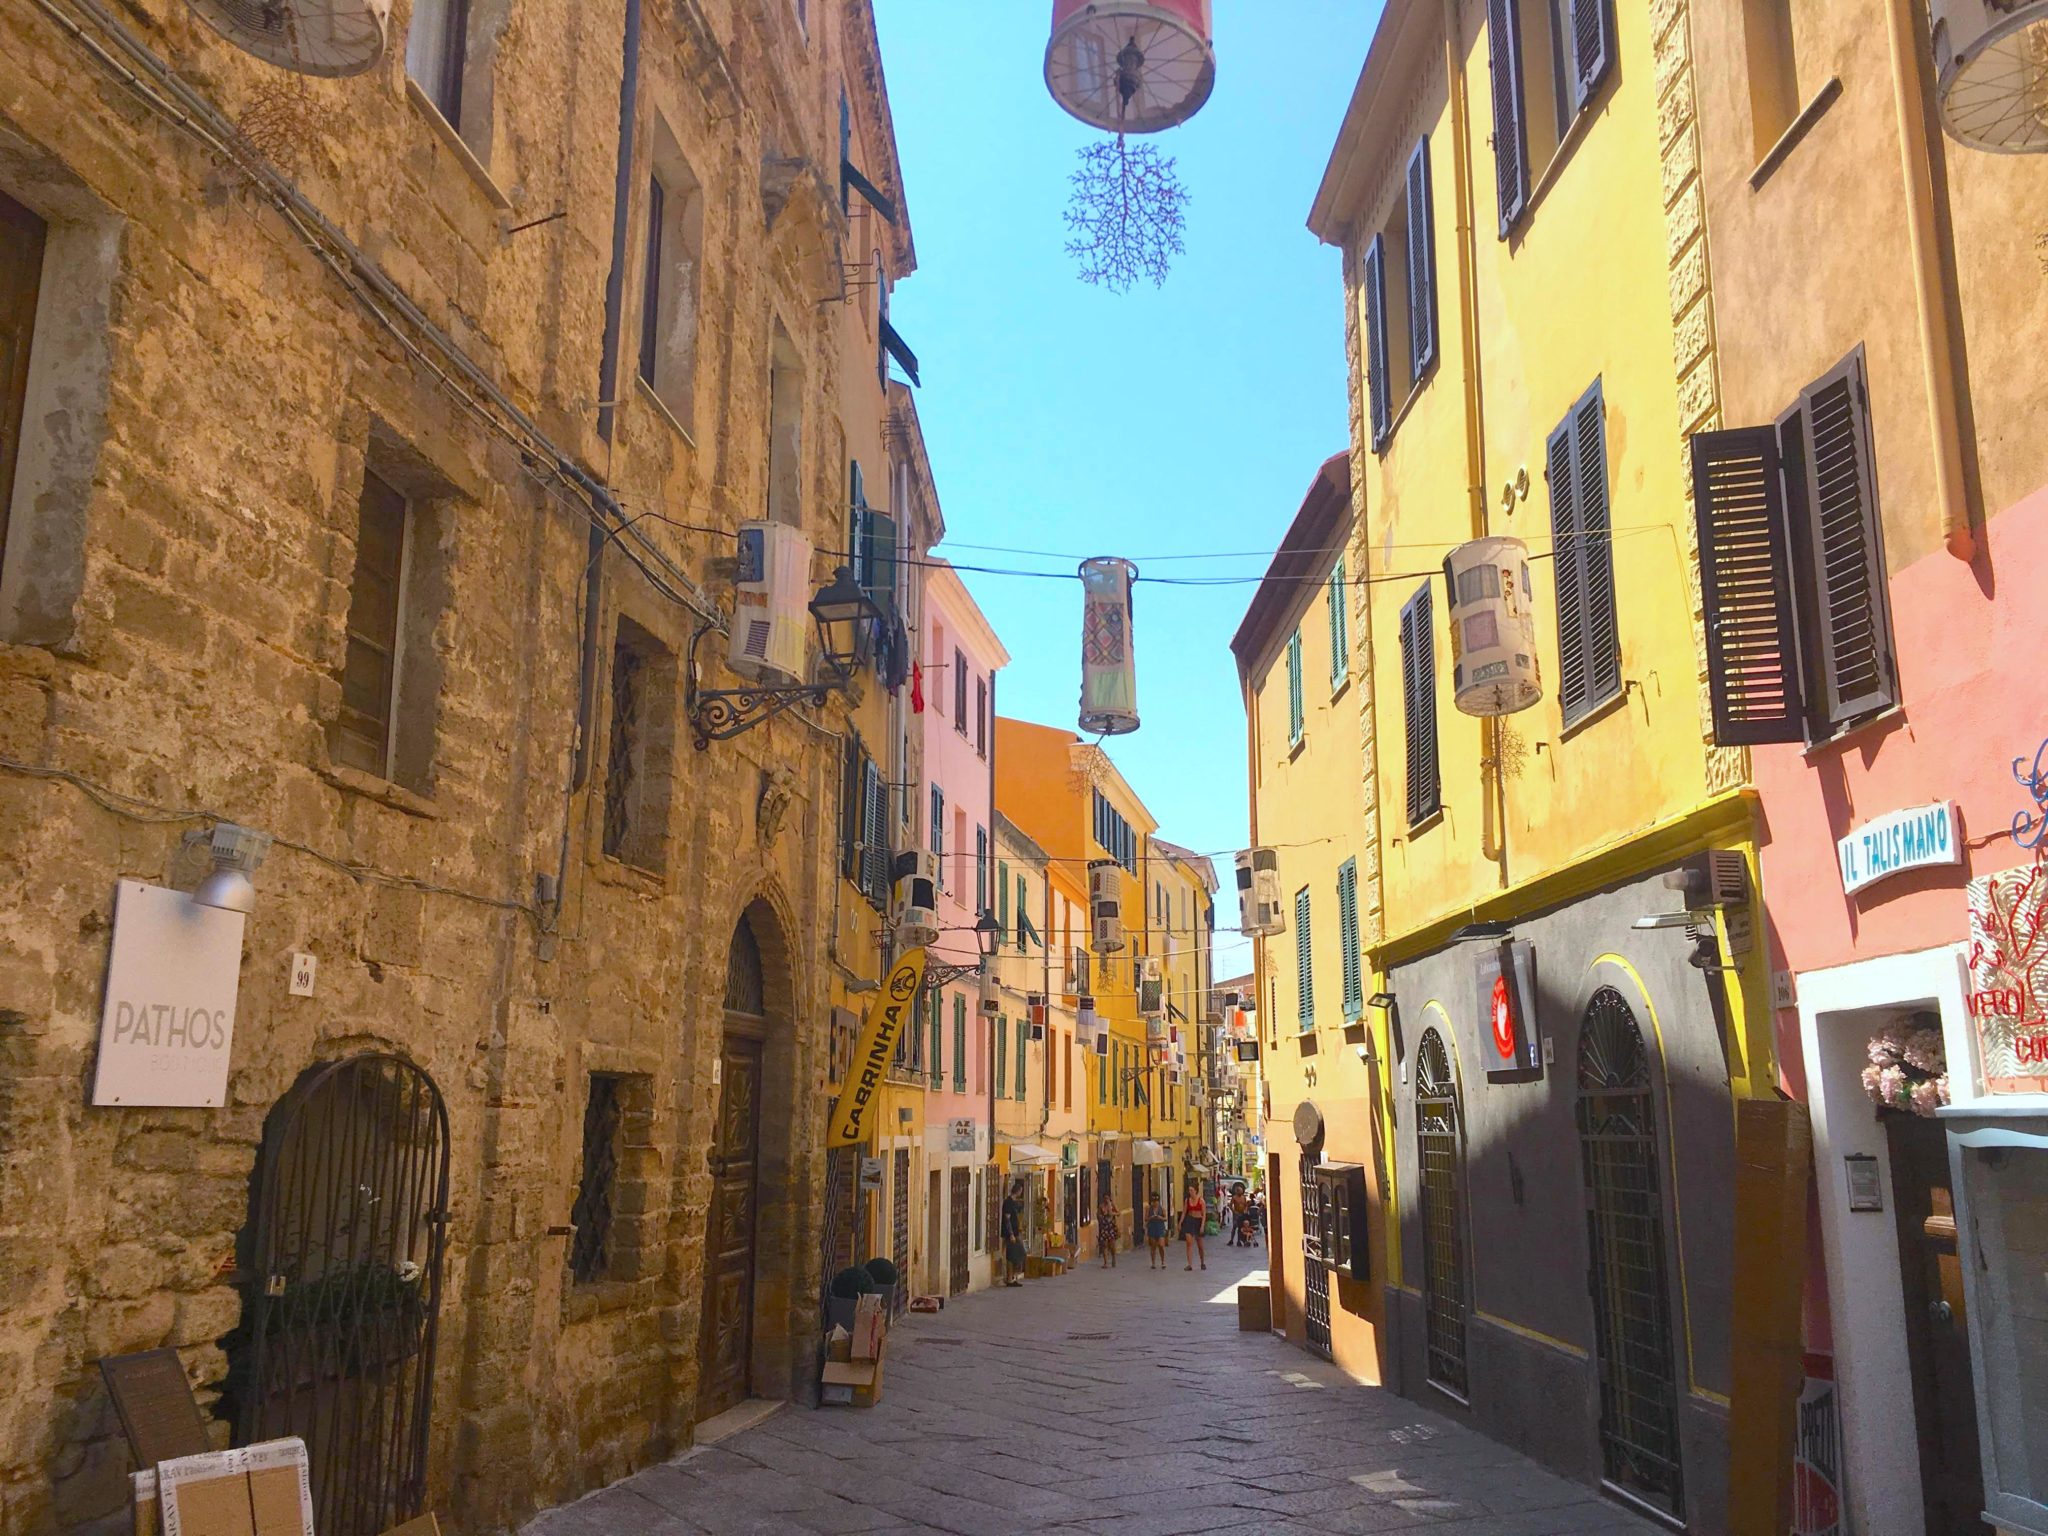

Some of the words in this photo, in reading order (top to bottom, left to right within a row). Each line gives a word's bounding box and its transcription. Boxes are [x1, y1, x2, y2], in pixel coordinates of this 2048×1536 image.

[1844, 842, 1857, 883] IL
[1863, 807, 1947, 876] TALISMANO
[296, 970, 310, 989] 99
[1966, 988, 2020, 1018] VERO
[113, 1001, 226, 1050] PATHOS
[2015, 1034, 2048, 1064] CU
[842, 1006, 902, 1140] CABRINHA
